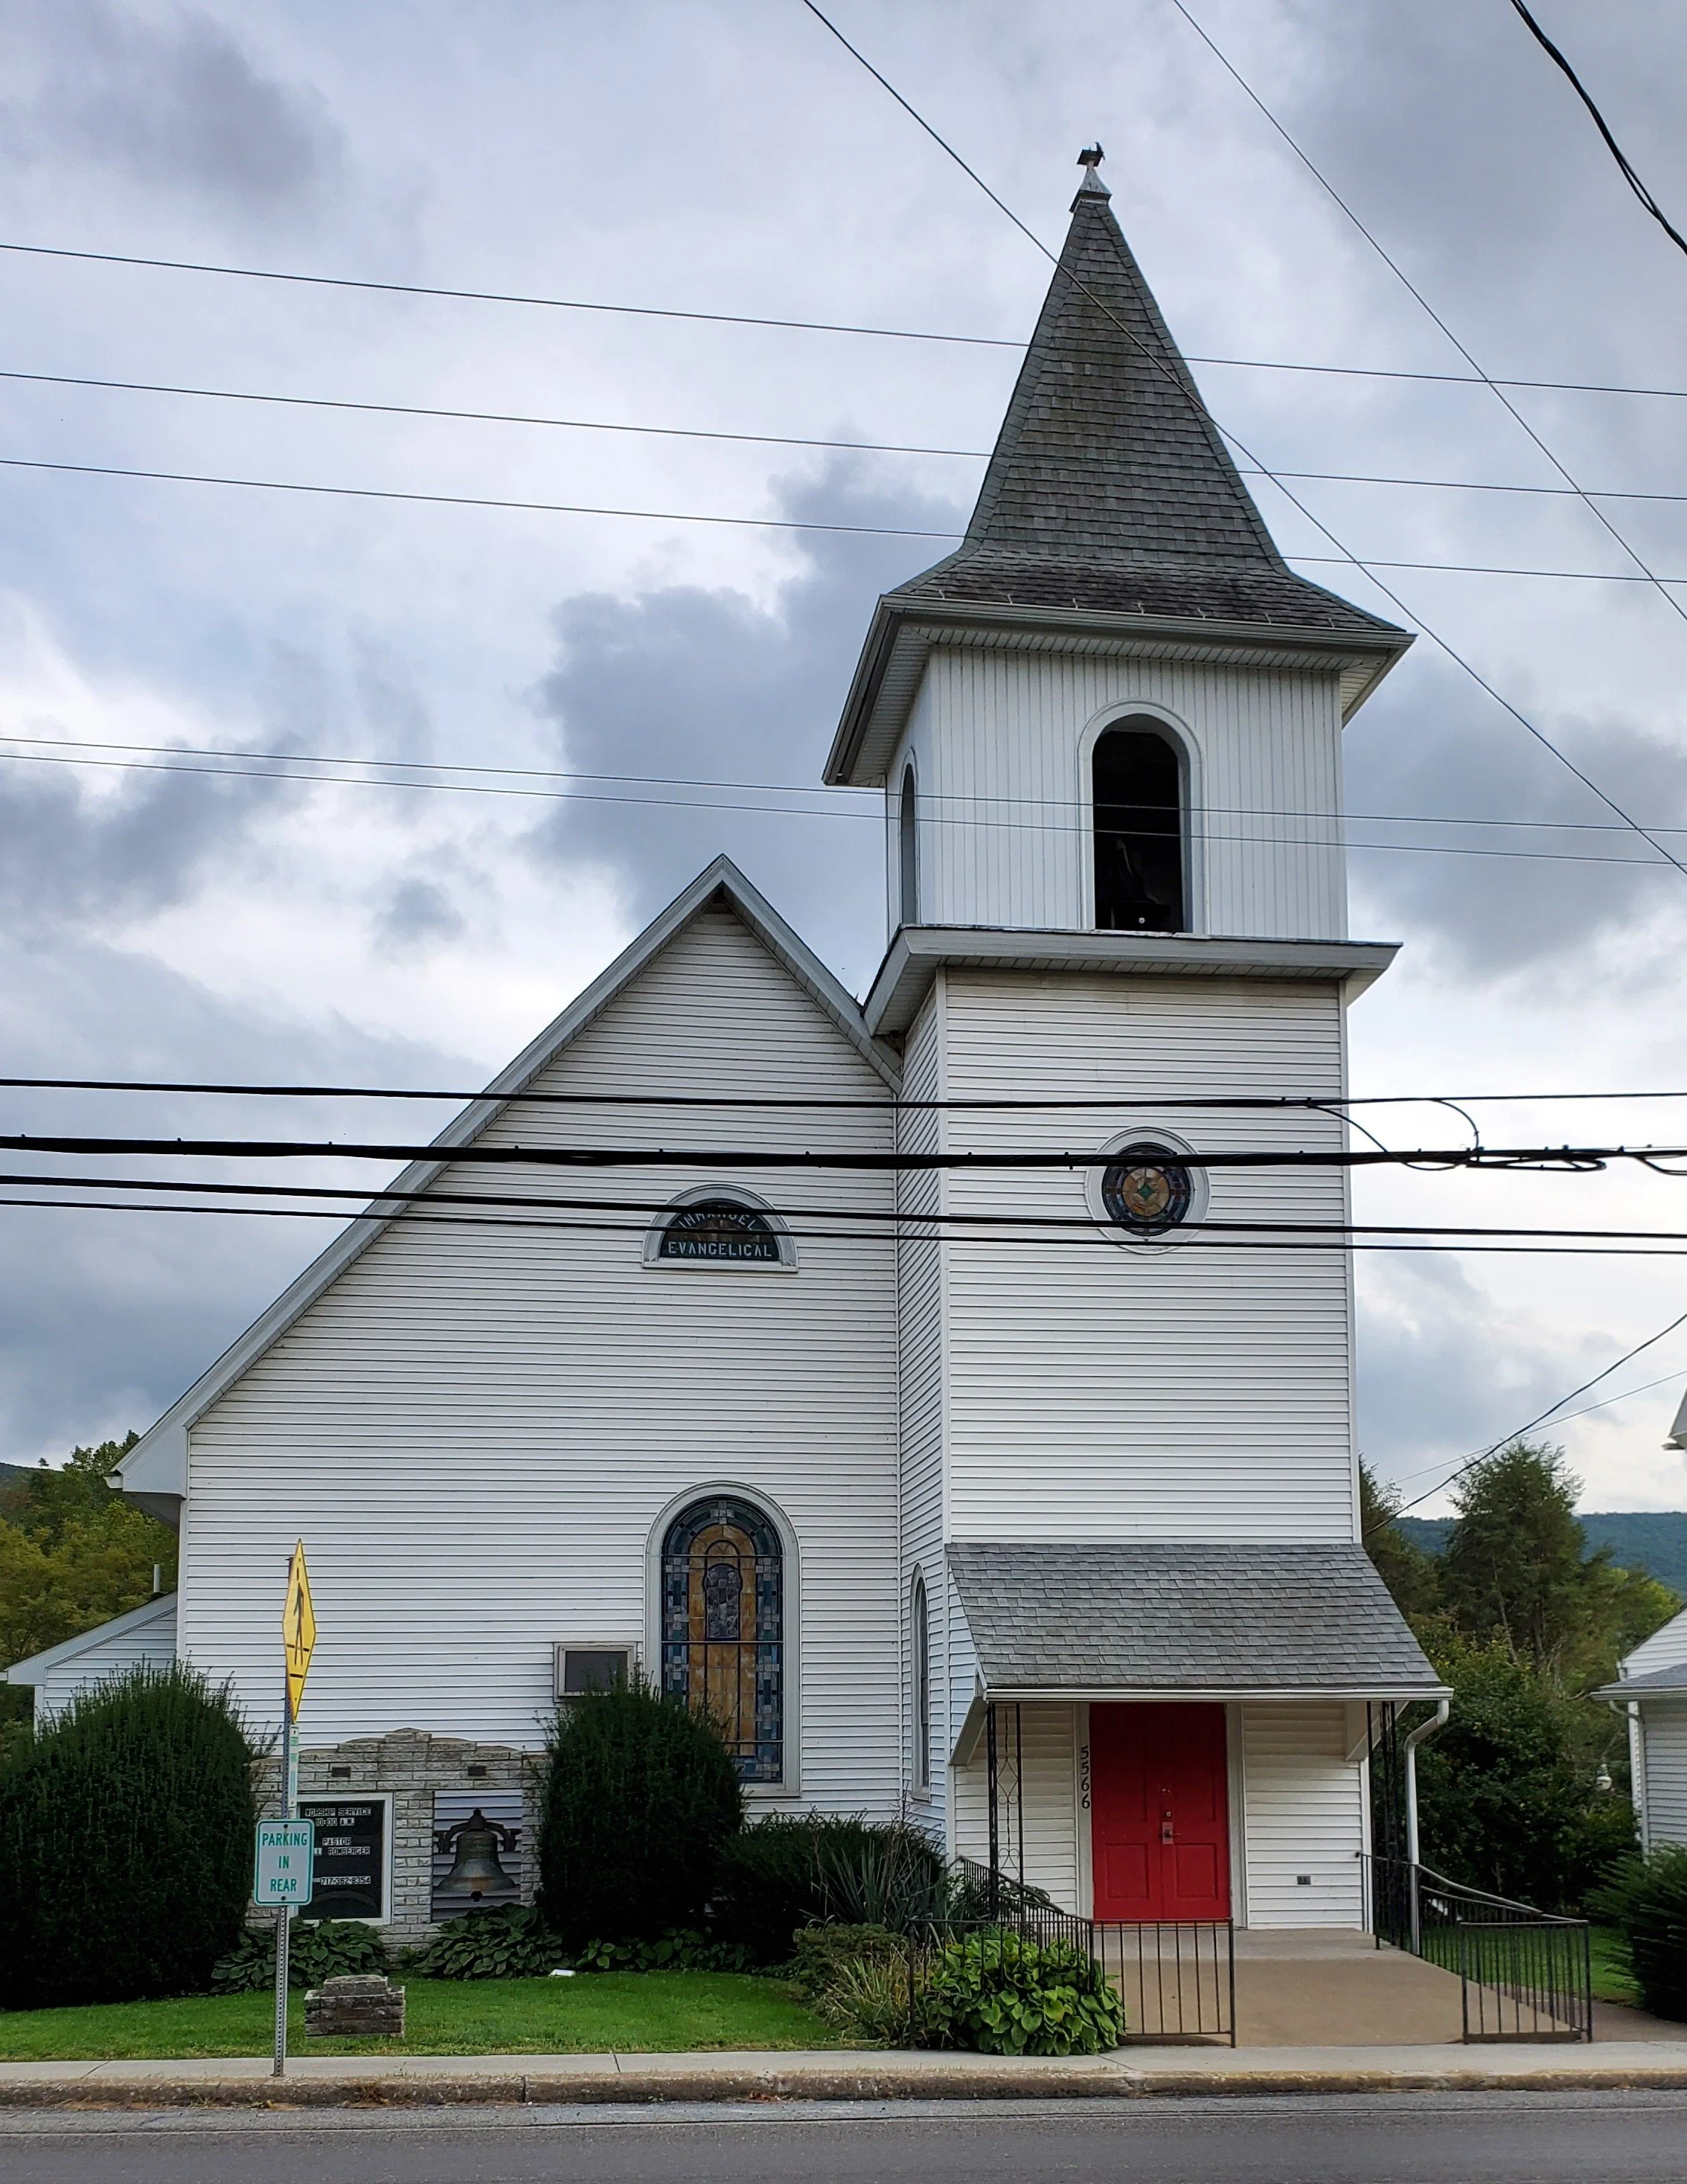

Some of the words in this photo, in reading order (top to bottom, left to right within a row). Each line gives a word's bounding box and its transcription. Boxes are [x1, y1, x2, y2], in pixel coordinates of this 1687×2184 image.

[668, 1241, 772, 1258] EVANGELICAL
[1081, 1745, 1091, 1809] 5566
[305, 1808, 336, 1816] WORSHIP
[339, 1807, 371, 1816] SERVICE
[316, 1818, 337, 1826] 10:00
[262, 1833, 307, 1845] PARKING
[322, 1837, 351, 1845] PASTOR
[327, 1846, 371, 1855] ROMBERGER
[278, 1855, 289, 1868] IN
[270, 1878, 297, 1892] REAR
